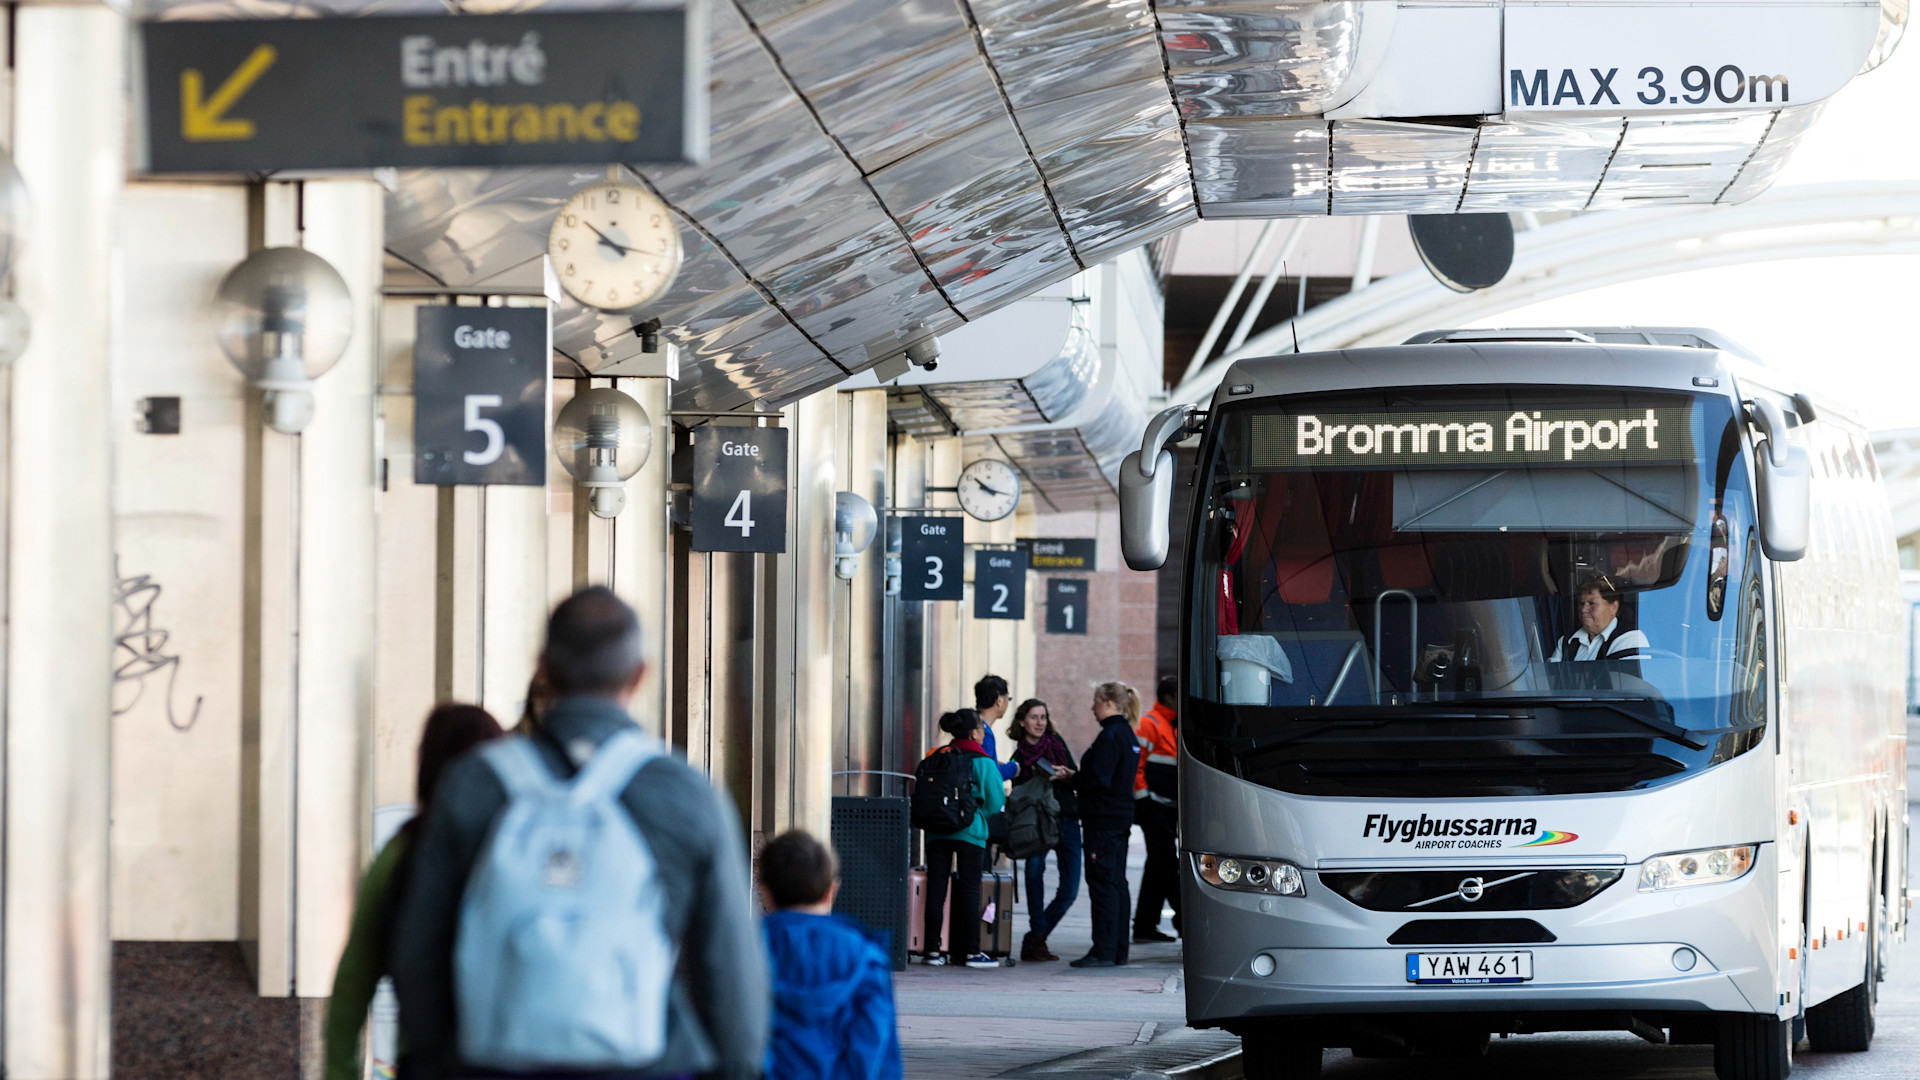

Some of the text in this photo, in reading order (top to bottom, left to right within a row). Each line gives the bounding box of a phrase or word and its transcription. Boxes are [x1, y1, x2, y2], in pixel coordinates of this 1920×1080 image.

[402, 31, 546, 87] Entré
[1510, 64, 1790, 106] MAX 3.90m
[403, 96, 640, 145] Entrance
[454, 325, 511, 349] Gate
[463, 394, 506, 466] 5
[1296, 409, 1659, 461] Bromma Airport
[721, 441, 760, 457] Gate
[724, 489, 756, 537] 4
[920, 523, 946, 536] Gate
[924, 555, 943, 590] 3
[989, 557, 1012, 568] Gate
[1032, 554, 1084, 566] Entrance
[991, 584, 1009, 613] 2
[1063, 605, 1074, 629] 1
[1363, 813, 1537, 842] Flygbussarna
[1414, 839, 1502, 849] AIRPORT COACHES
[1427, 956, 1519, 976] YAW 461
